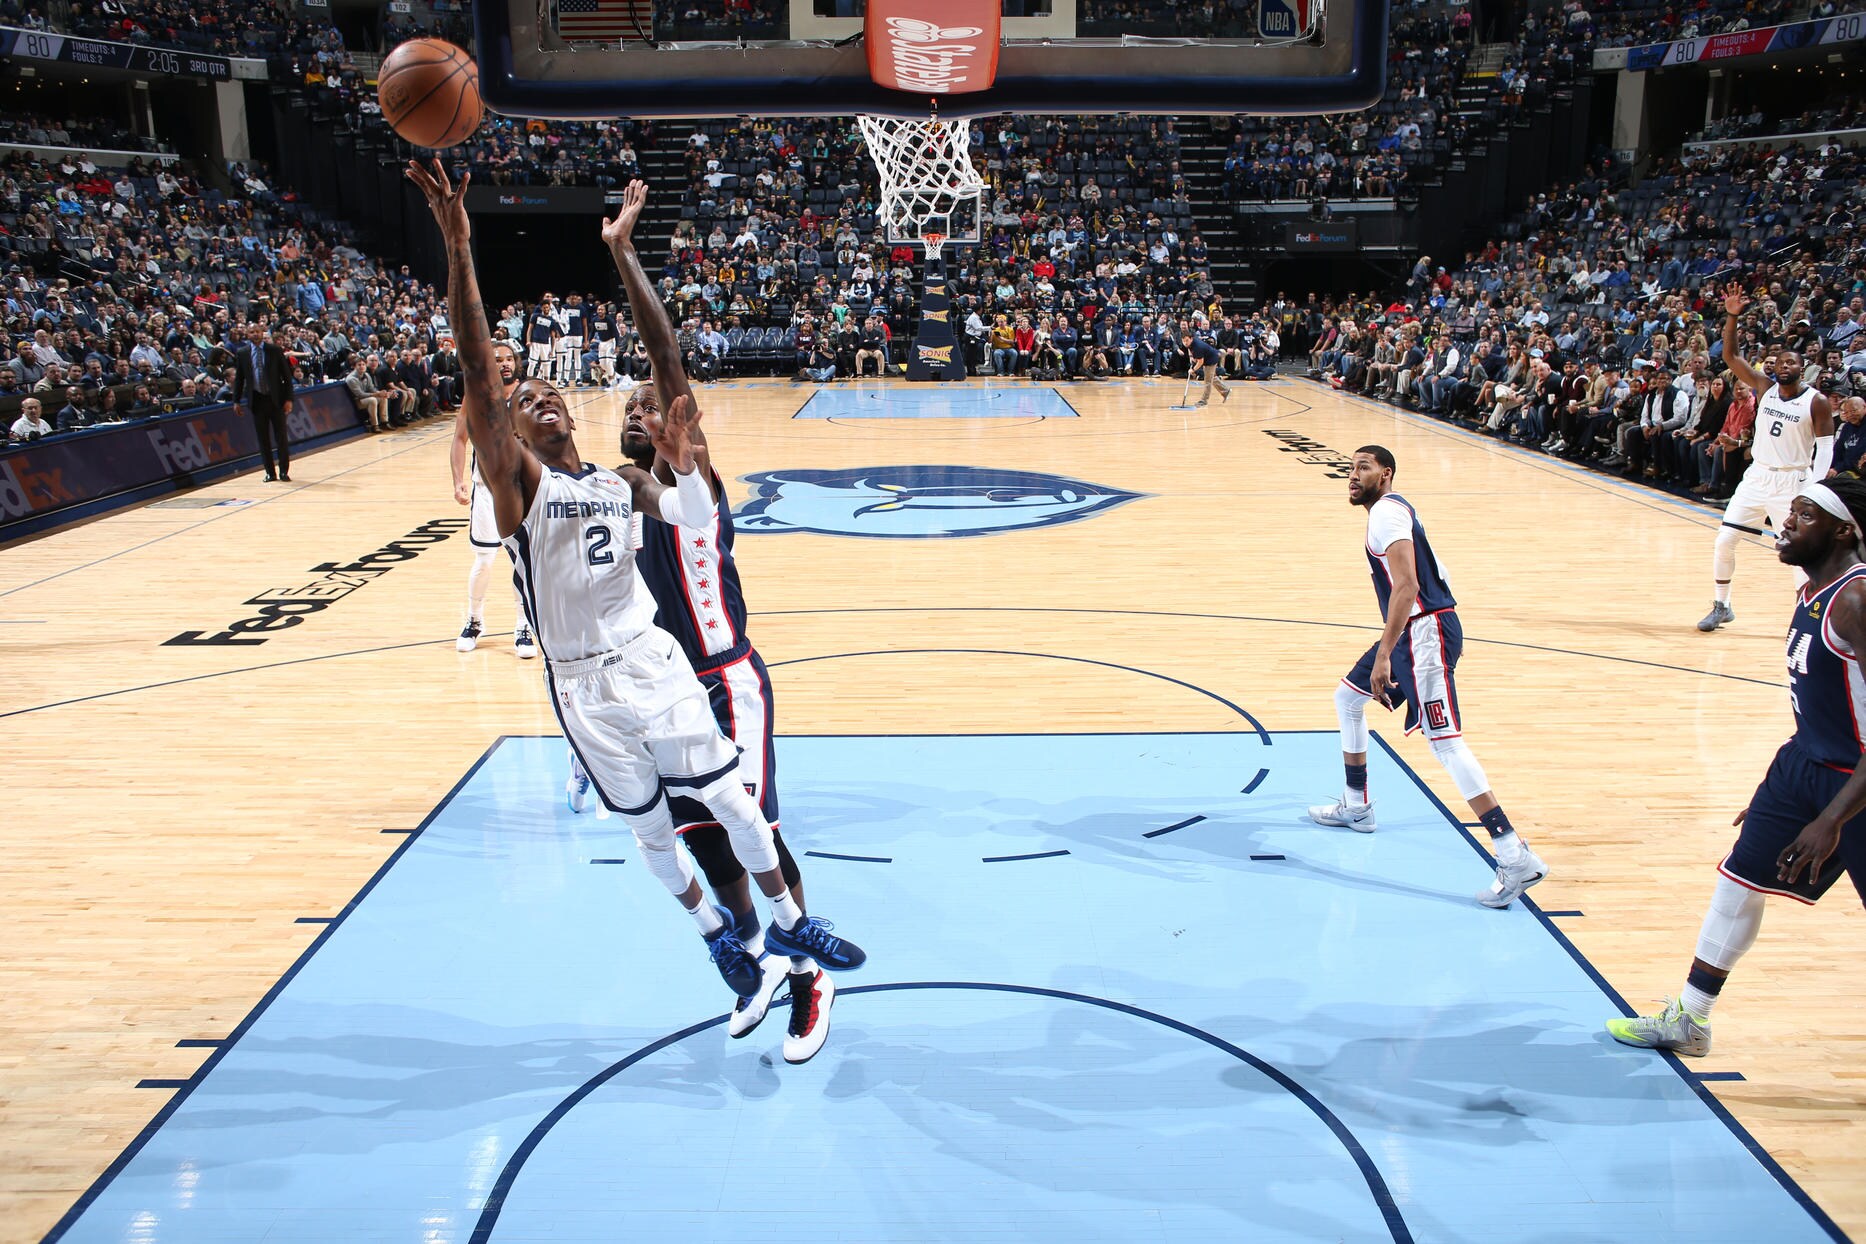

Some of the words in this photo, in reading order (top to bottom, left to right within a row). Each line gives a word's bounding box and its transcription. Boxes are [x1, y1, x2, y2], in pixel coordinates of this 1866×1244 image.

[1266, 11, 1290, 31] NBA
[1836, 16, 1859, 41] 80
[27, 34, 50, 57] 80
[71, 41, 110, 55] TIMEOUTS:
[111, 46, 116, 55] 4
[1713, 35, 1749, 47] TIMEOUTS:
[1751, 33, 1756, 41] 4
[72, 52, 97, 63] FOULS:
[98, 55, 103, 64] 2
[1676, 41, 1695, 63] 80
[1711, 48, 1735, 58] FOULS:
[1736, 47, 1741, 55] 3
[148, 50, 180, 74] 2:05
[190, 60, 208, 73] 3RD
[921, 349, 950, 358] SONIC
[1762, 407, 1800, 423] MEMPHIS
[1770, 421, 1783, 437] 6
[147, 419, 239, 475] FedEx
[547, 501, 630, 519] MEMPHIS
[586, 525, 614, 566] 2
